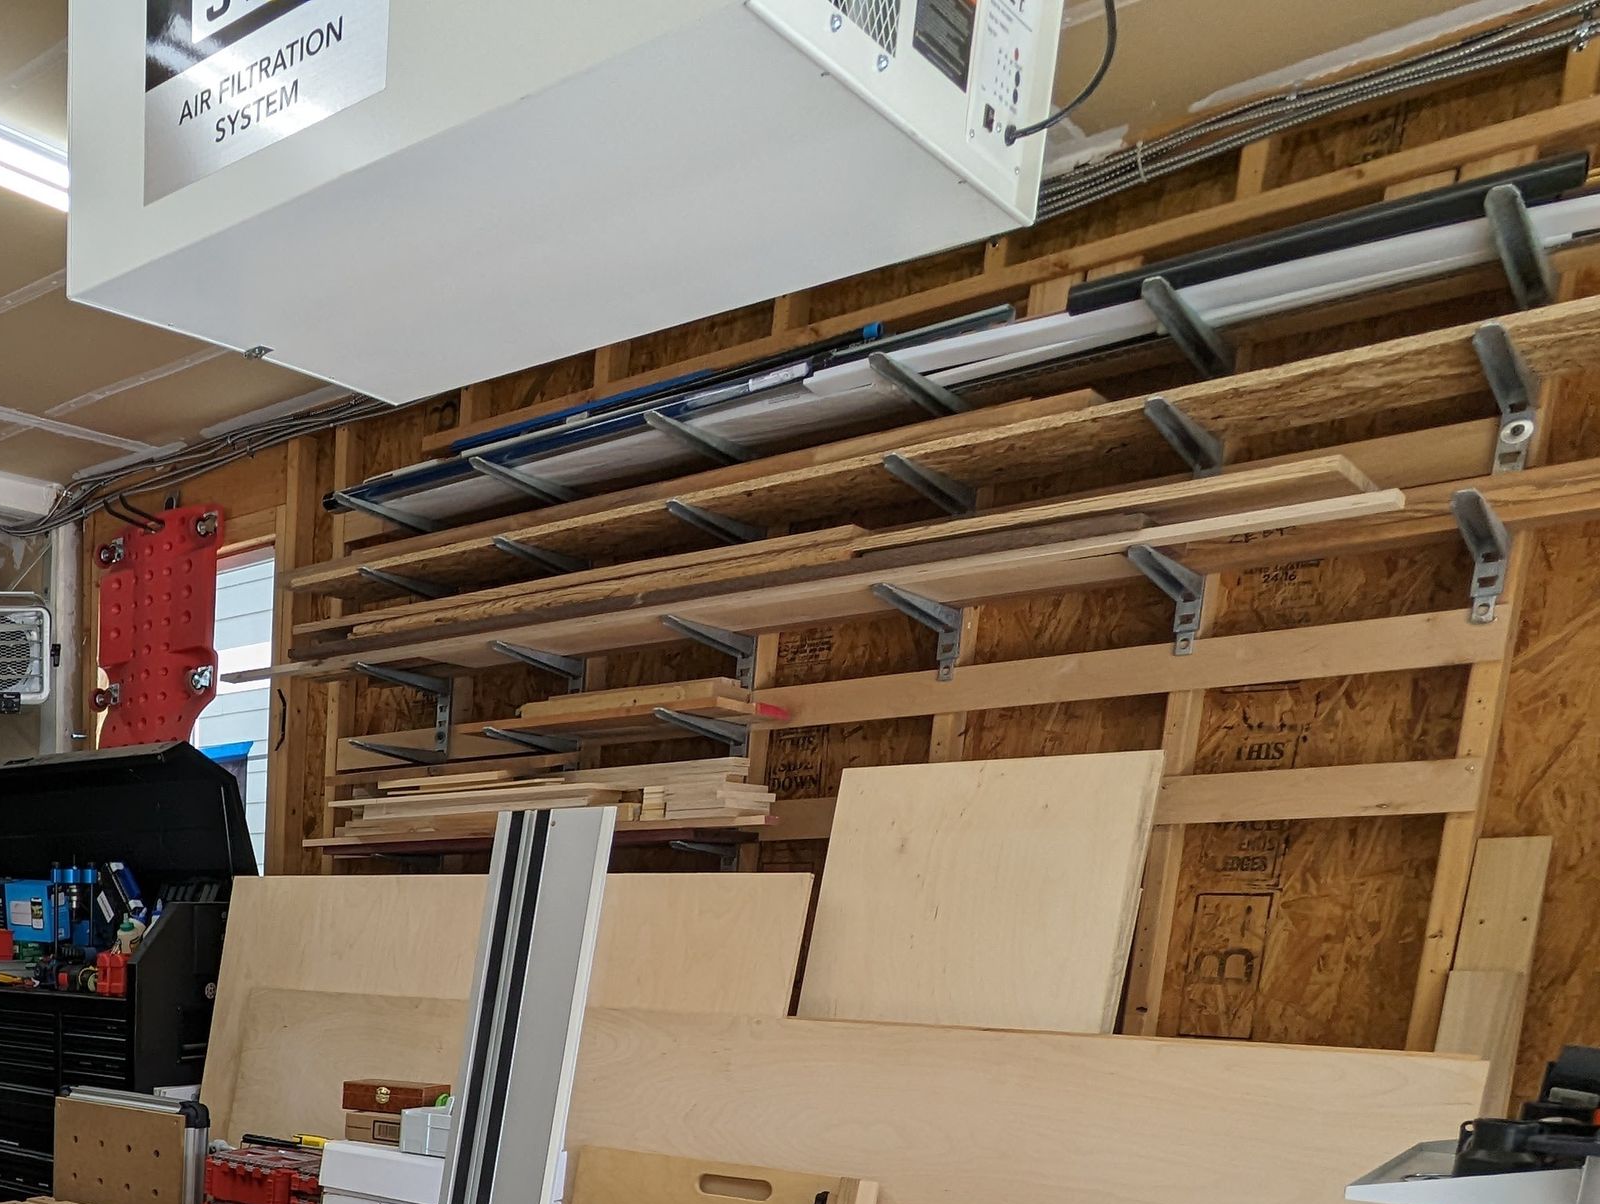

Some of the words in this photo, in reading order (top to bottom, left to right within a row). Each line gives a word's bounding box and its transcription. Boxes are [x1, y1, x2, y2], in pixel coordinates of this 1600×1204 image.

[178, 88, 212, 126] AIR
[219, 15, 344, 105] FILTRATION
[215, 78, 299, 143] SYSTEM
